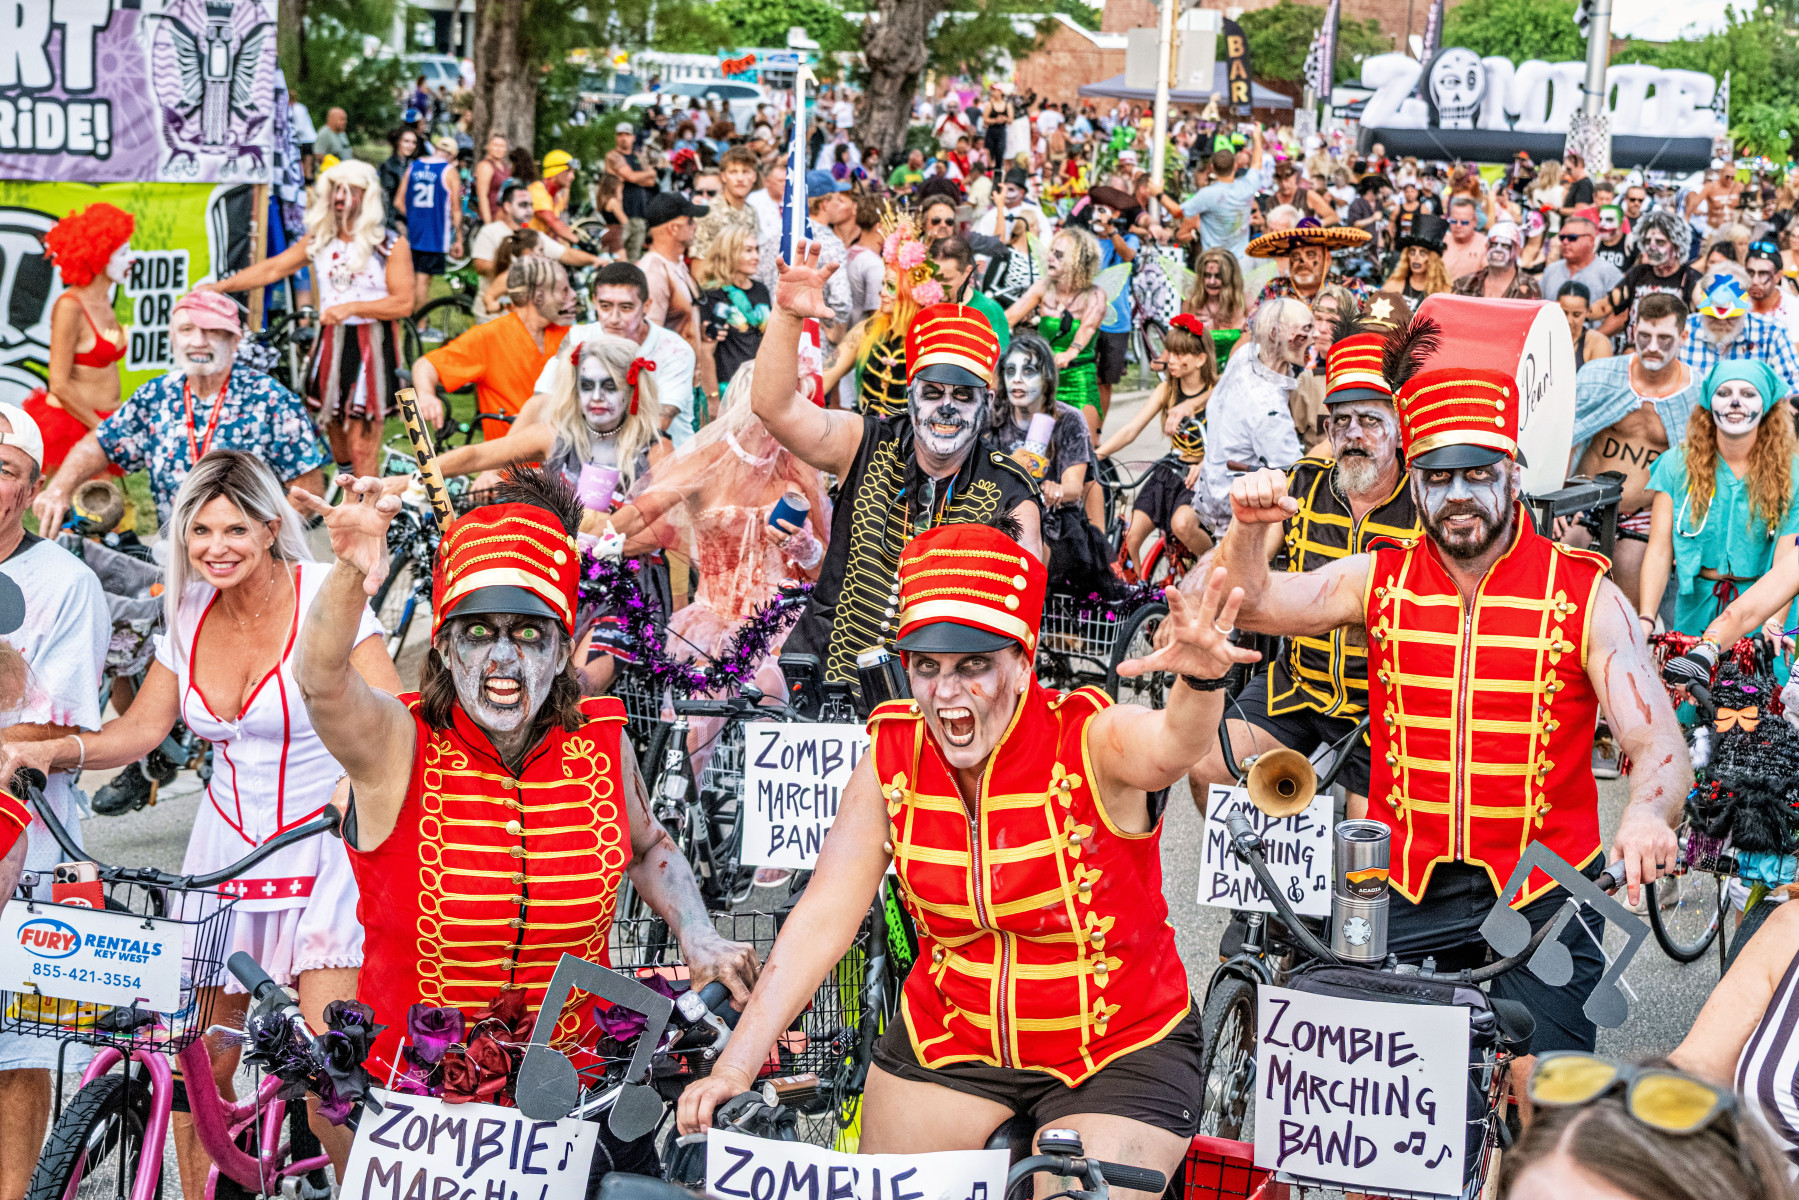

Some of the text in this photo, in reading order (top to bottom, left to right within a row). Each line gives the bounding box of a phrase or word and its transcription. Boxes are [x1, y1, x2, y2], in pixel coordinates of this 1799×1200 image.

[1227, 35, 1248, 102] BAR
[413, 182, 435, 208] 21
[129, 257, 185, 290] RIDE
[140, 293, 172, 327] OR
[1519, 330, 1553, 431] Pearl
[754, 731, 871, 780] ZOMBI
[767, 823, 831, 860] BAN
[1207, 829, 1314, 879] MAHING
[20, 928, 162, 957] FURY RENTALS
[94, 949, 150, 964] KEY WEST
[33, 963, 141, 989] 855-421-3554
[1263, 998, 1419, 1068] ZOMBIE
[1266, 1054, 1436, 1126] MARCHING
[369, 1101, 557, 1179] ZOMBIE
[1276, 1119, 1377, 1168] BAND
